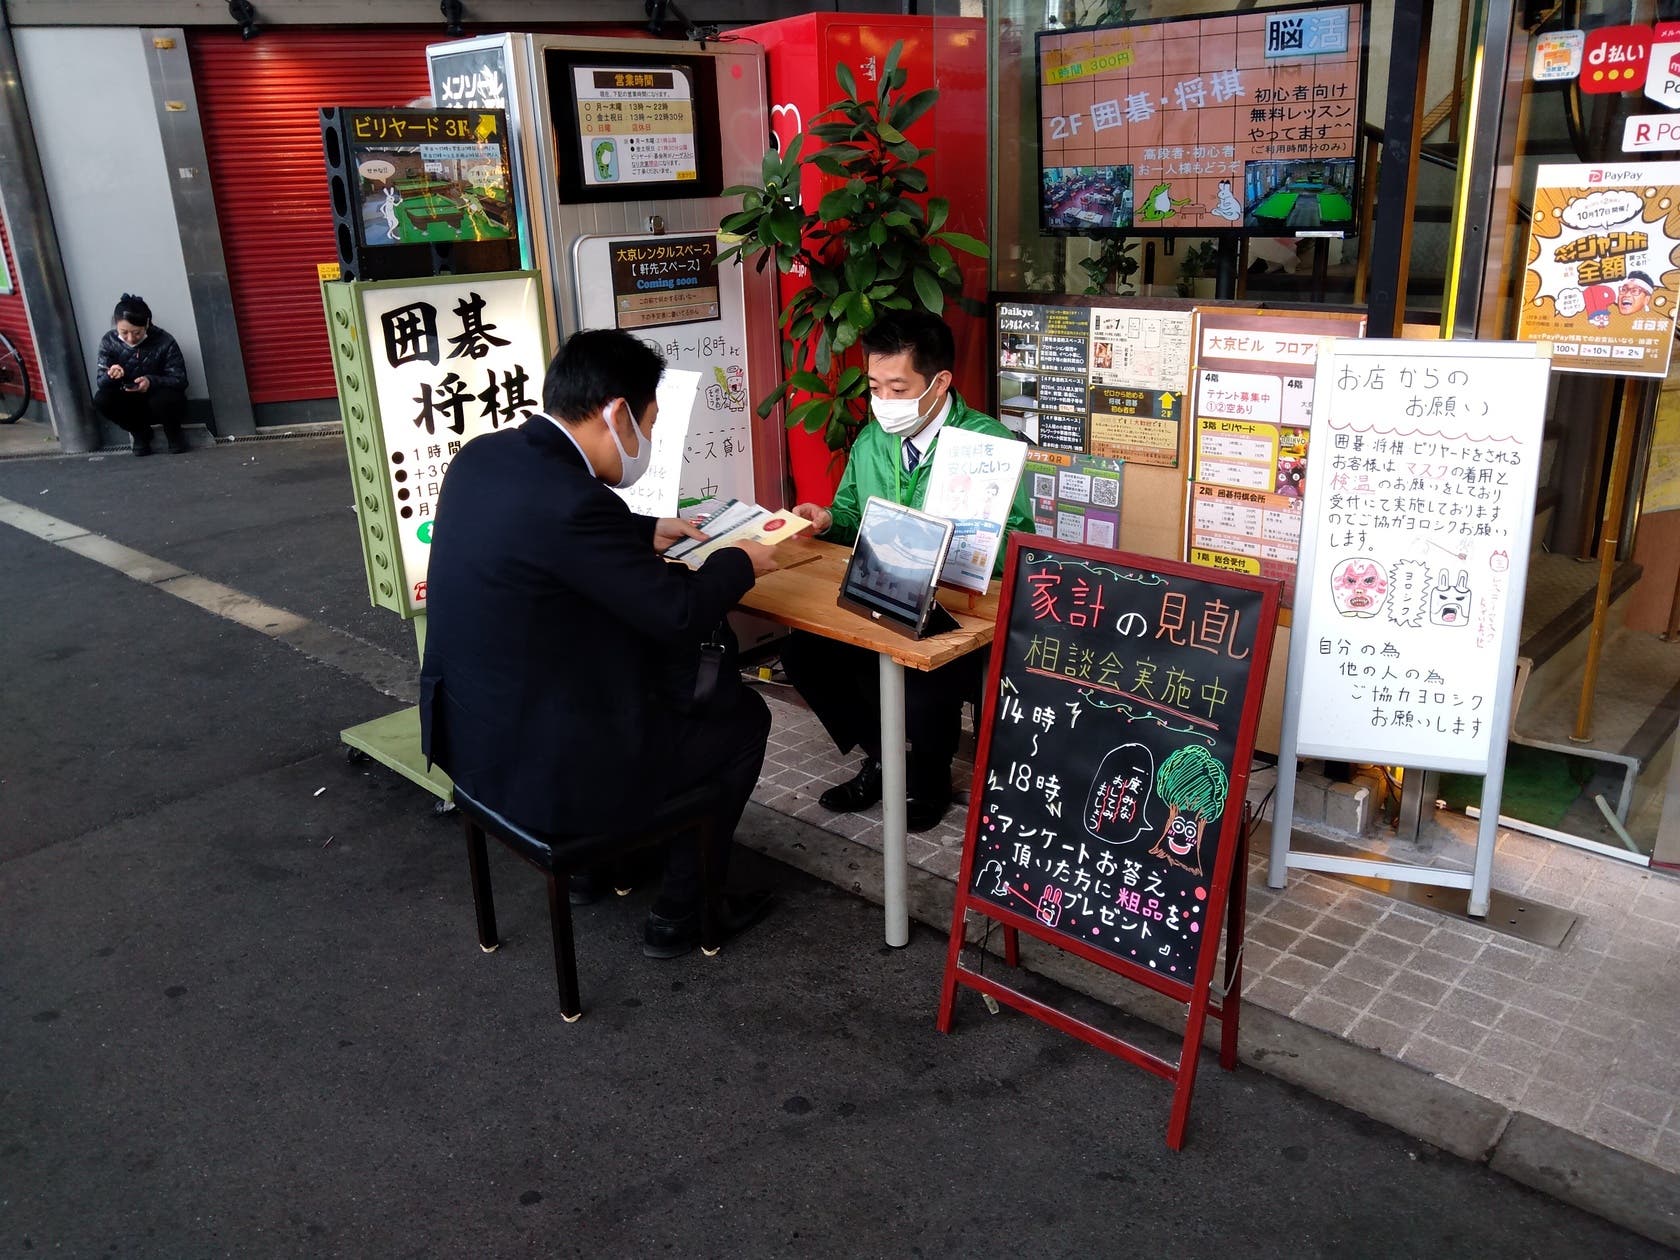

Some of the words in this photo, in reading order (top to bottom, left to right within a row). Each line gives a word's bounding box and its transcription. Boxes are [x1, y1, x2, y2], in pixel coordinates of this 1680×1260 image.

[1268, 15, 1345, 51] 脳活
[1589, 42, 1643, 65] d払い
[614, 74, 654, 87] 営業時間
[1254, 83, 1348, 103] 初心者向け
[1250, 105, 1351, 122] 無料レッスン
[355, 117, 440, 138] ビリヤード
[1050, 113, 1082, 140] 2F
[1634, 123, 1650, 142] R
[1138, 160, 1240, 176] お一人様もどうぞ
[1604, 171, 1643, 181] PayPay
[616, 243, 712, 262] 大京レンタルスペース
[1577, 255, 1627, 286] 全額
[636, 279, 674, 290] Coming
[676, 276, 698, 286] soon
[1001, 306, 1034, 317] Daikyo
[381, 292, 512, 369] 囲碁
[1000, 320, 1040, 331] レンタルスペース
[1209, 335, 1265, 351] 大京ビル
[1205, 373, 1219, 383] 4階
[1288, 379, 1303, 389] 4階
[413, 364, 538, 435] 将棋
[1207, 389, 1270, 402] テナント募集中
[1405, 395, 1489, 418] お願い
[1203, 421, 1216, 431] 3階
[1221, 424, 1255, 433] ビリヤード
[1200, 486, 1213, 496] 2階
[1217, 489, 1266, 503] 囲碁将棋会所
[1329, 529, 1374, 551] します。
[1197, 552, 1209, 561] 1階
[1214, 555, 1246, 568] 総合受付
[1401, 572, 1412, 616] ヨロシク
[1027, 567, 1249, 660] 家計の見直し
[1319, 637, 1400, 659] 自分の為
[1024, 634, 1228, 718] 相談会実施中
[1340, 662, 1445, 685] 他の人の為
[1371, 707, 1482, 739] お願いします
[1008, 761, 1062, 803] 18時
[1012, 842, 1180, 931] 頂いた方に粗品を
